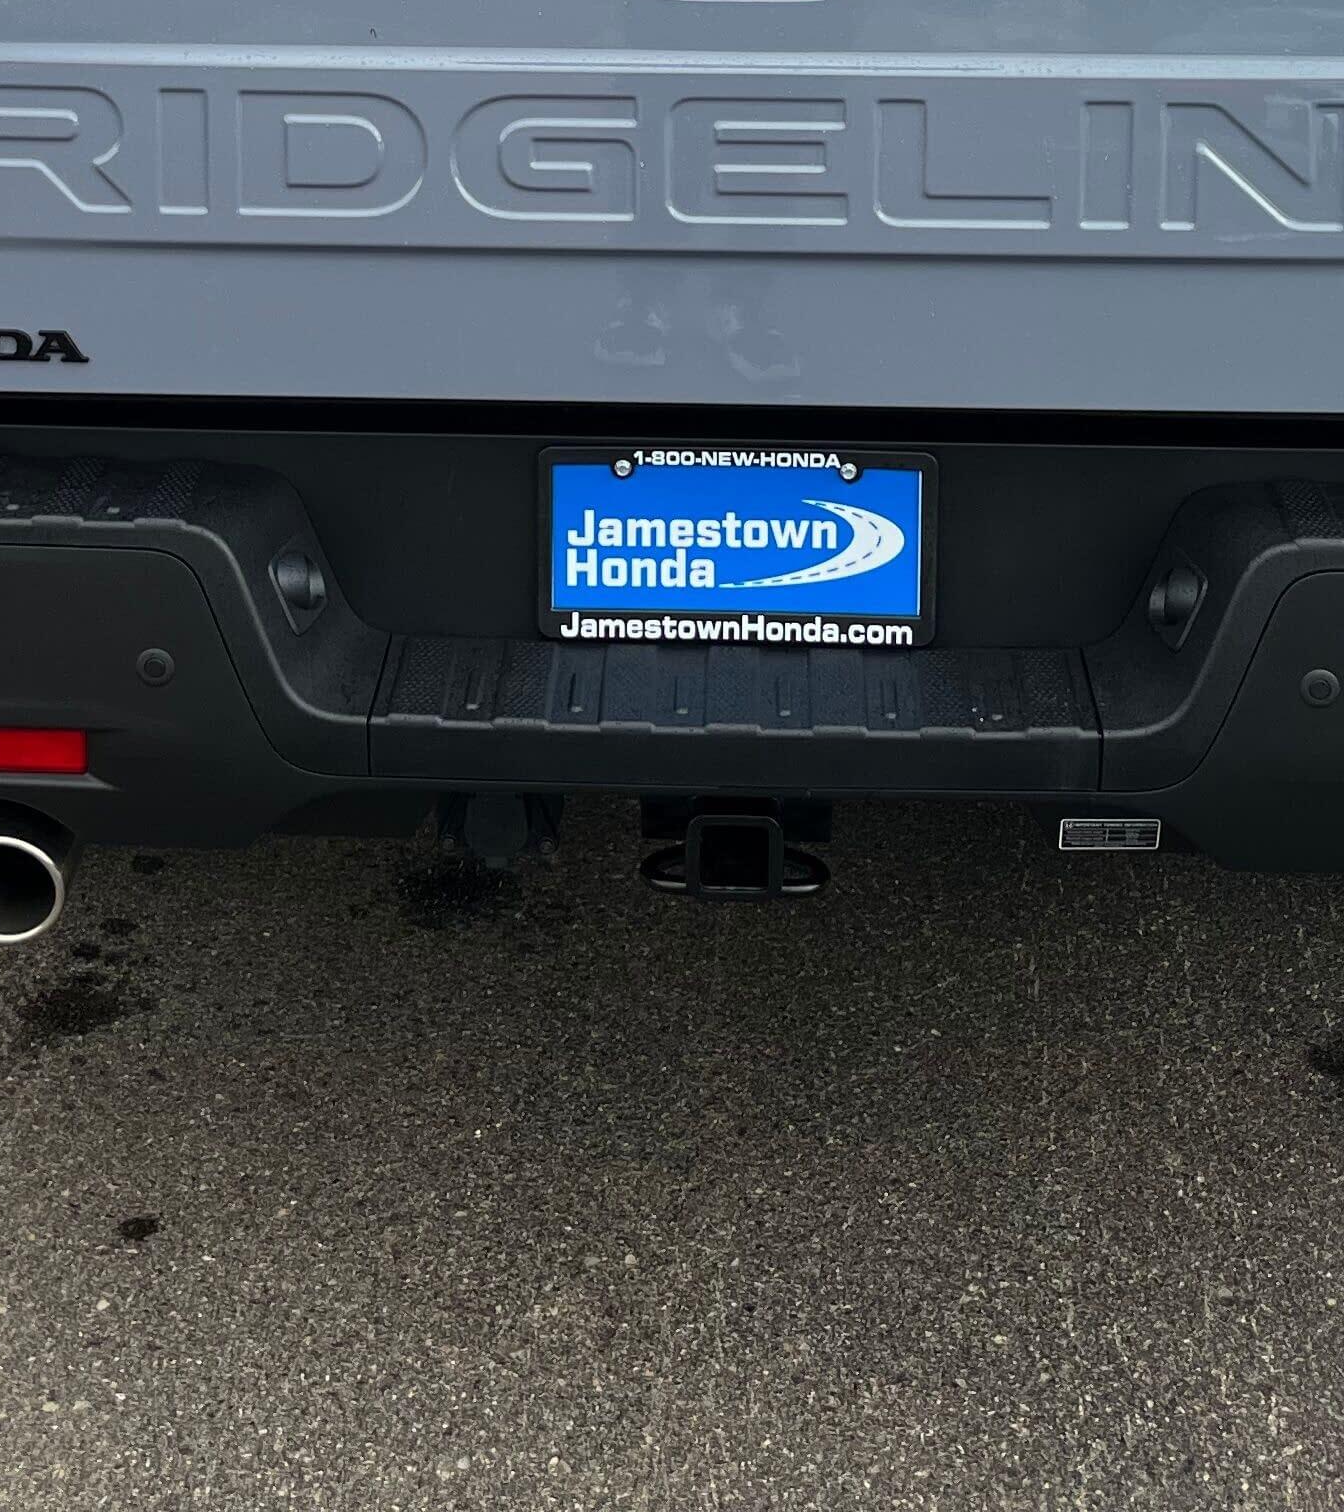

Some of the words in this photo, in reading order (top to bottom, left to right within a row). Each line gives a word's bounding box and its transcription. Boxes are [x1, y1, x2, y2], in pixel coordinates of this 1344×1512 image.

[633, 450, 841, 468] 1-800-NEW-HONDA
[567, 509, 837, 549] Jamestown
[566, 548, 716, 588] Honda
[560, 611, 913, 645] JamestownHonda.com
